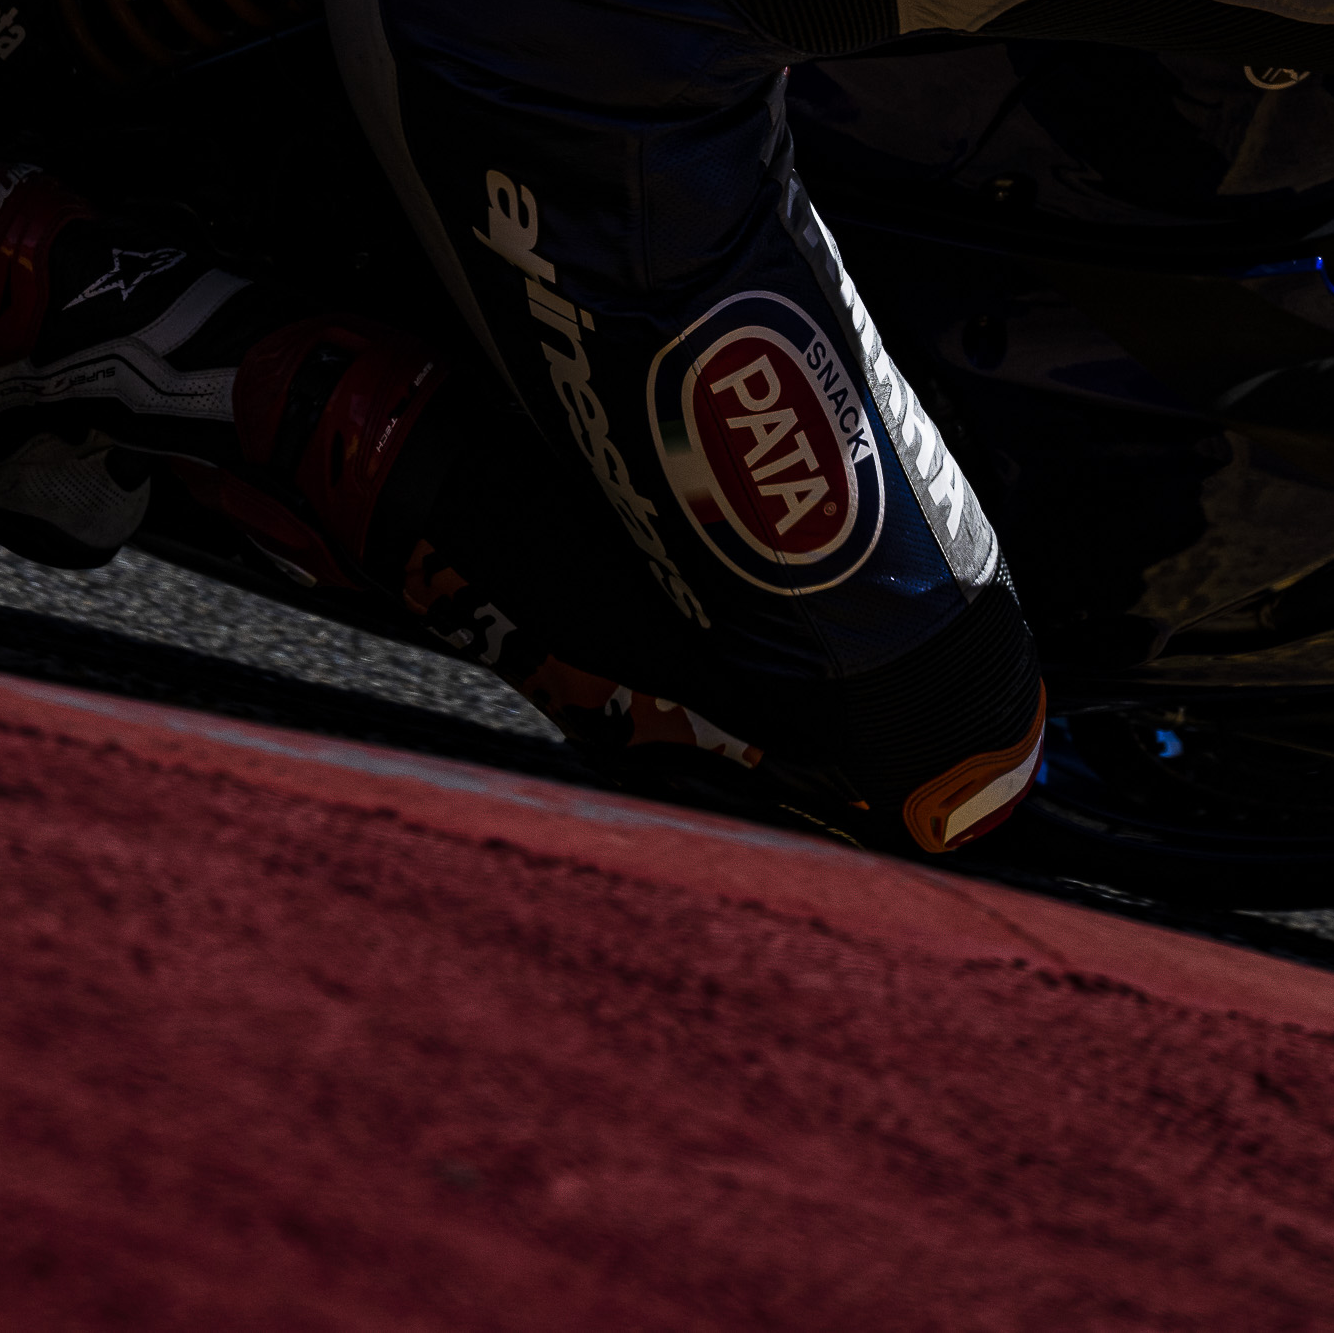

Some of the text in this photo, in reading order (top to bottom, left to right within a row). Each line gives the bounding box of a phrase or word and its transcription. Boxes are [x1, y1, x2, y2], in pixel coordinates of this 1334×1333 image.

[471, 168, 713, 631] alpinestars
[709, 355, 830, 537] PATA
[805, 339, 871, 464] SNACK
